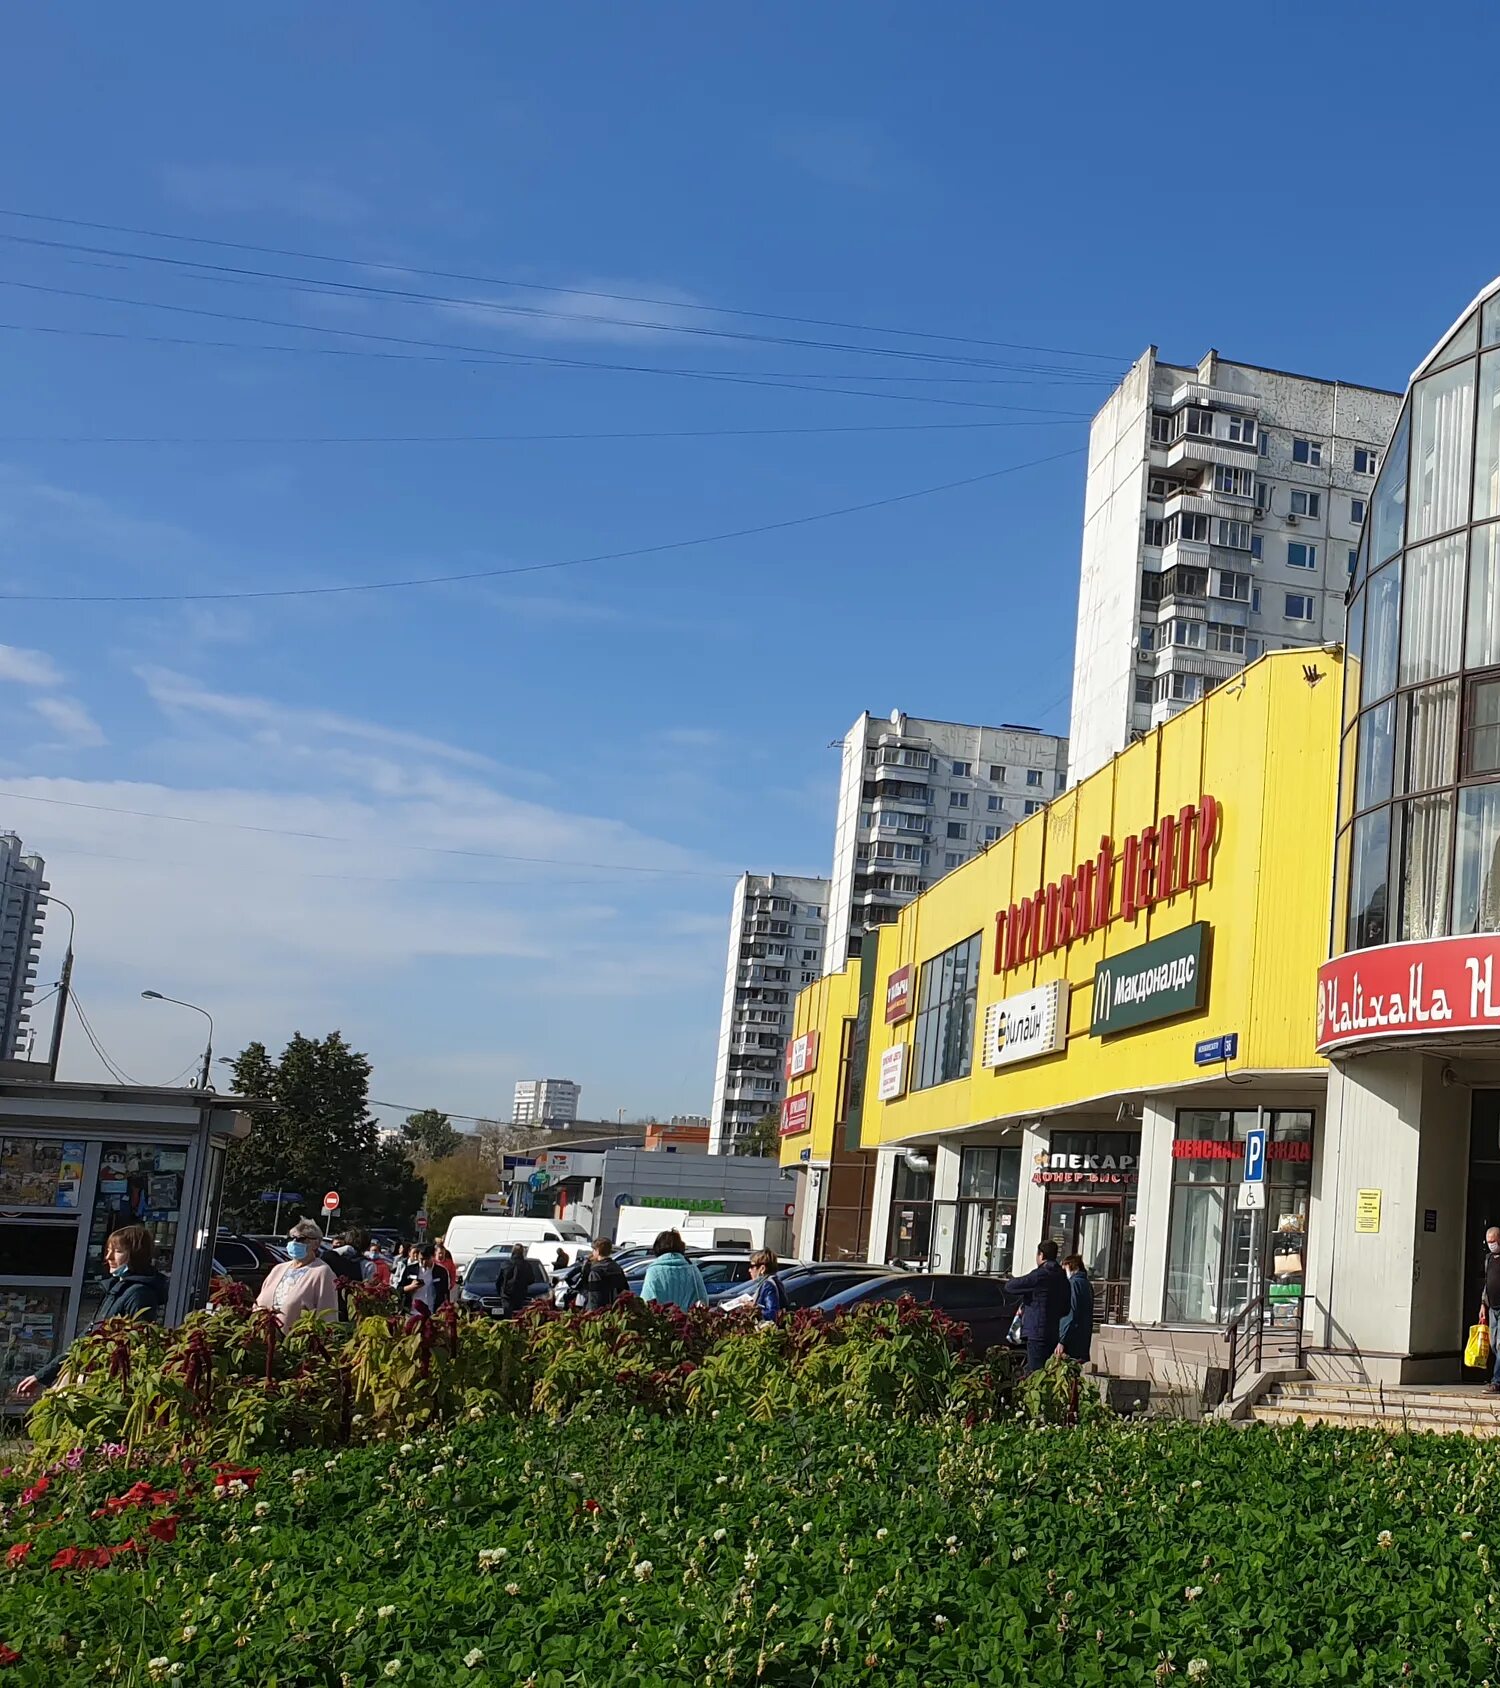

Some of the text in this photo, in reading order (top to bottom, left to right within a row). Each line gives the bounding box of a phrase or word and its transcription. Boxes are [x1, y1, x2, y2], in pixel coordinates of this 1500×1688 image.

[993, 795, 1218, 975] ТОРГОВЫЙ ЦЕНТР
[1113, 954, 1195, 1005] Макдоналдс
[1051, 1153, 1140, 1169] ПЕКАР
[1172, 1140, 1312, 1162] ЖЕНСКАЯ ЕЖДА
[1032, 1171, 1083, 1184] ДОНЕР
